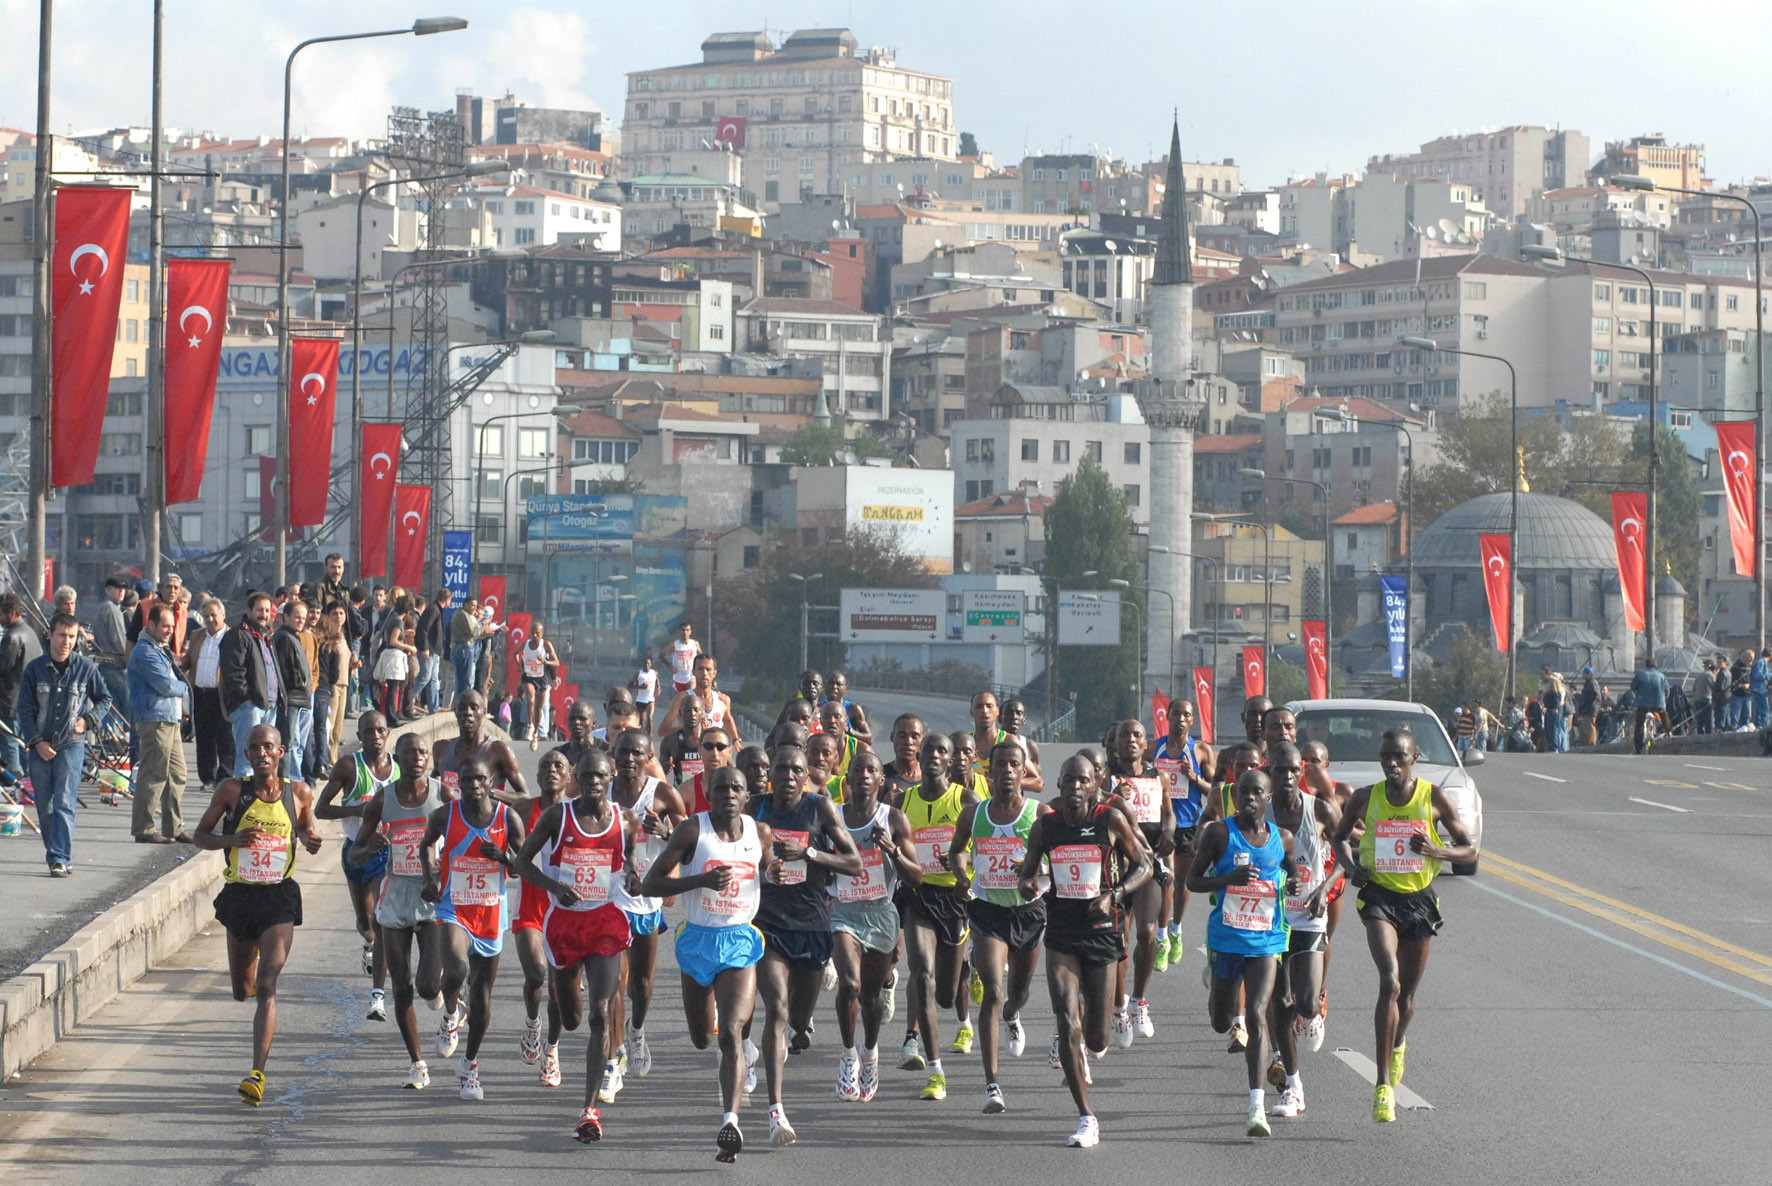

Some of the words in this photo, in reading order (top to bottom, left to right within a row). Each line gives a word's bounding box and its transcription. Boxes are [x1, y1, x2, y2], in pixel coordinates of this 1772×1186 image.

[878, 486, 924, 495] REZERVASYON
[528, 500, 560, 514] Dünya
[562, 515, 598, 528] Otogaz
[445, 554, 468, 568] 84.
[444, 568, 468, 587] yılı
[451, 589, 467, 598] utlu
[1386, 595, 1405, 607] 84.
[1133, 793, 1150, 807] 40
[933, 844, 941, 859] 8
[1394, 839, 1405, 856] 6
[251, 851, 271, 868] 34
[989, 856, 1008, 872] 24
[1389, 857, 1423, 865] İSTANBUL
[575, 867, 596, 884] 63
[989, 873, 1018, 882] İSTANBU
[1070, 864, 1080, 881] 9
[466, 873, 486, 890] 15
[851, 884, 885, 896] İSTANBUL
[702, 897, 713, 906] 29.
[1240, 897, 1260, 913] 77
[1235, 912, 1270, 924] İSTANBUL
